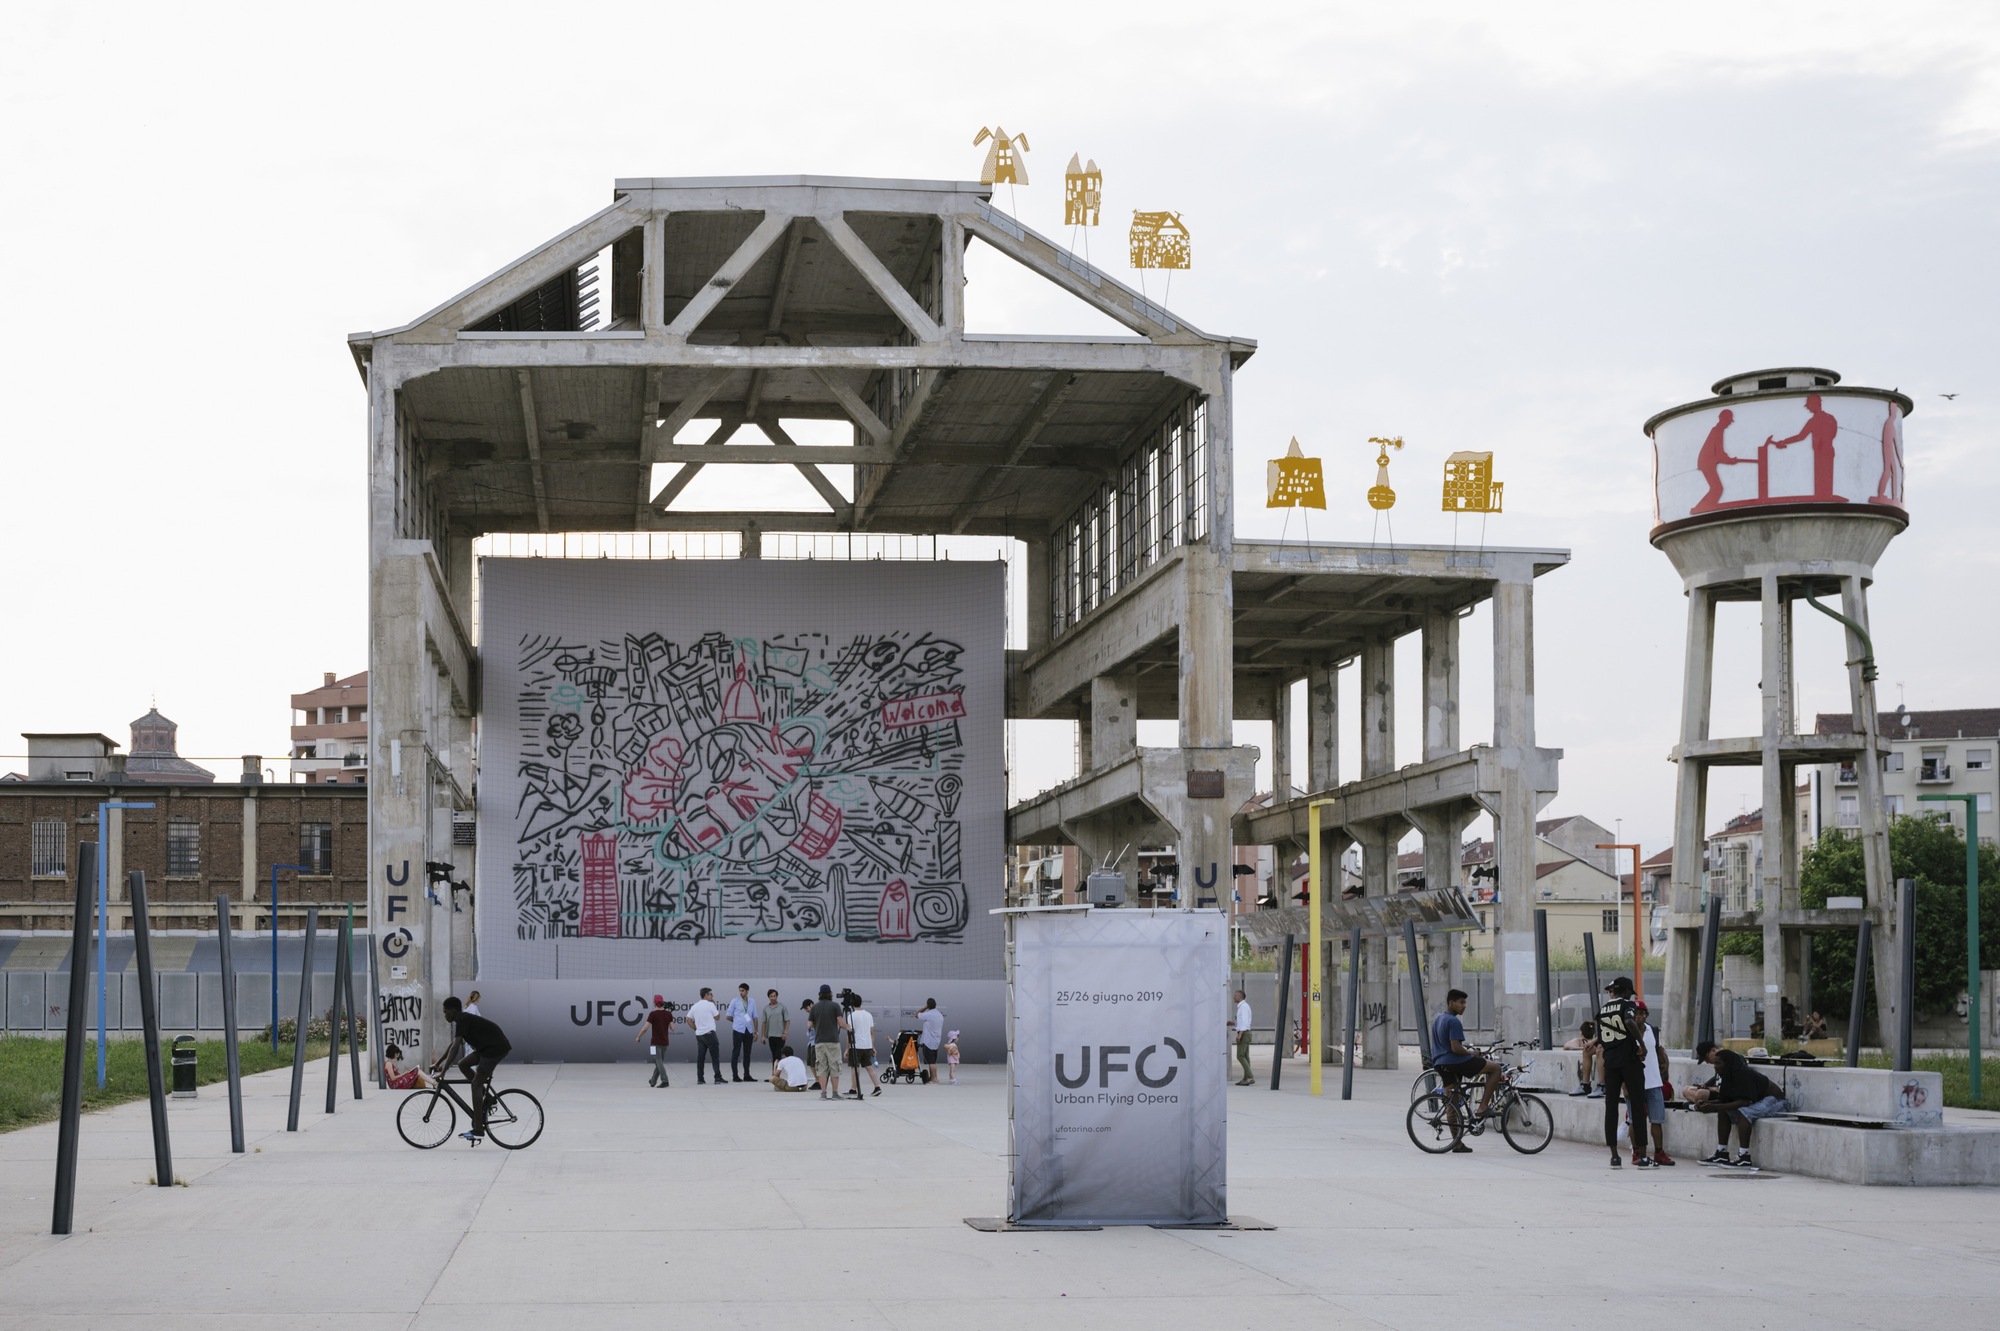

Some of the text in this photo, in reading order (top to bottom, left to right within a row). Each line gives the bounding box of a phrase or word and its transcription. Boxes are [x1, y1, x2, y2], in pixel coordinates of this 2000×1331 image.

[767, 649, 799, 667] TO
[882, 699, 961, 723] Welcome
[540, 865, 580, 883] LIFE
[382, 860, 413, 959] UFO
[1056, 990, 1164, 1005] 25/26 giugno 2019
[570, 995, 649, 1027] UFO
[1600, 1014, 1627, 1043] 80
[1054, 1036, 1187, 1089] UFO
[1054, 1092, 1179, 1106] Urban Flying Opera
[1055, 1124, 1112, 1133] ufotorino.com
